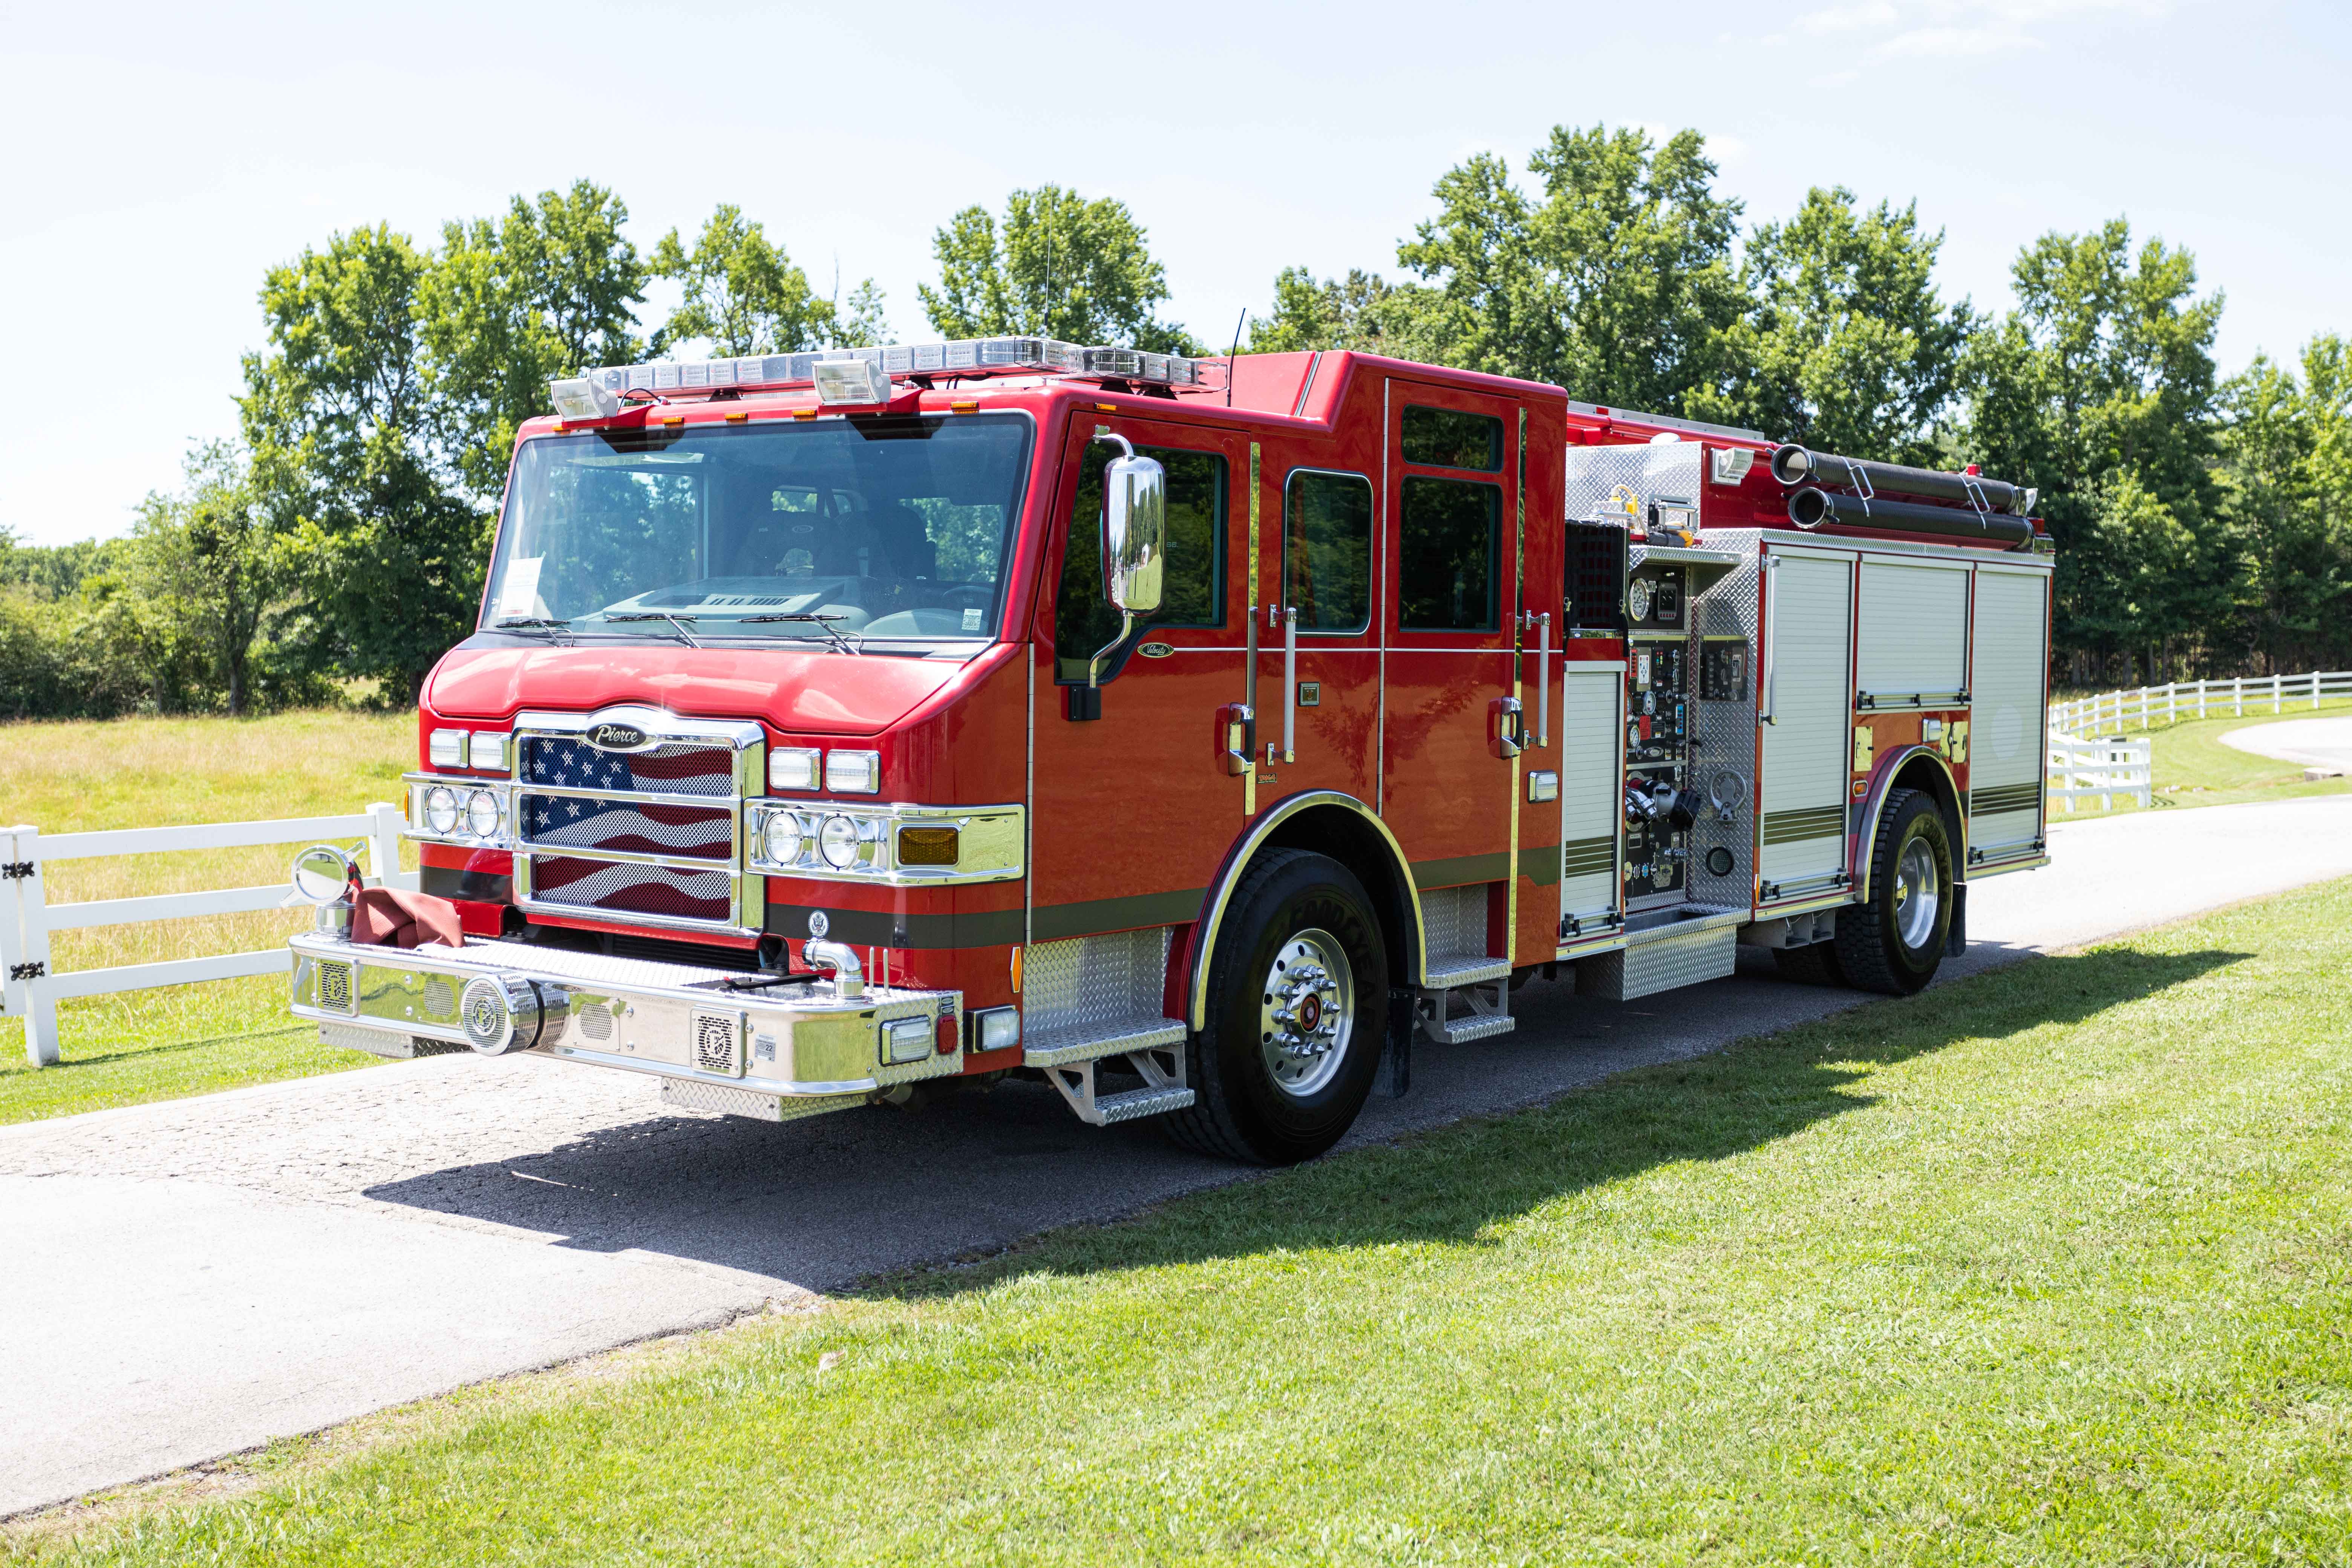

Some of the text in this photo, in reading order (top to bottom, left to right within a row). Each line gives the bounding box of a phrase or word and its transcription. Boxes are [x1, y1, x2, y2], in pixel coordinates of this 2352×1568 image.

[1147, 645, 1165, 655] Velocity
[596, 724, 638, 744] Pierce
[1290, 899, 1377, 1029] GOODYEAR
